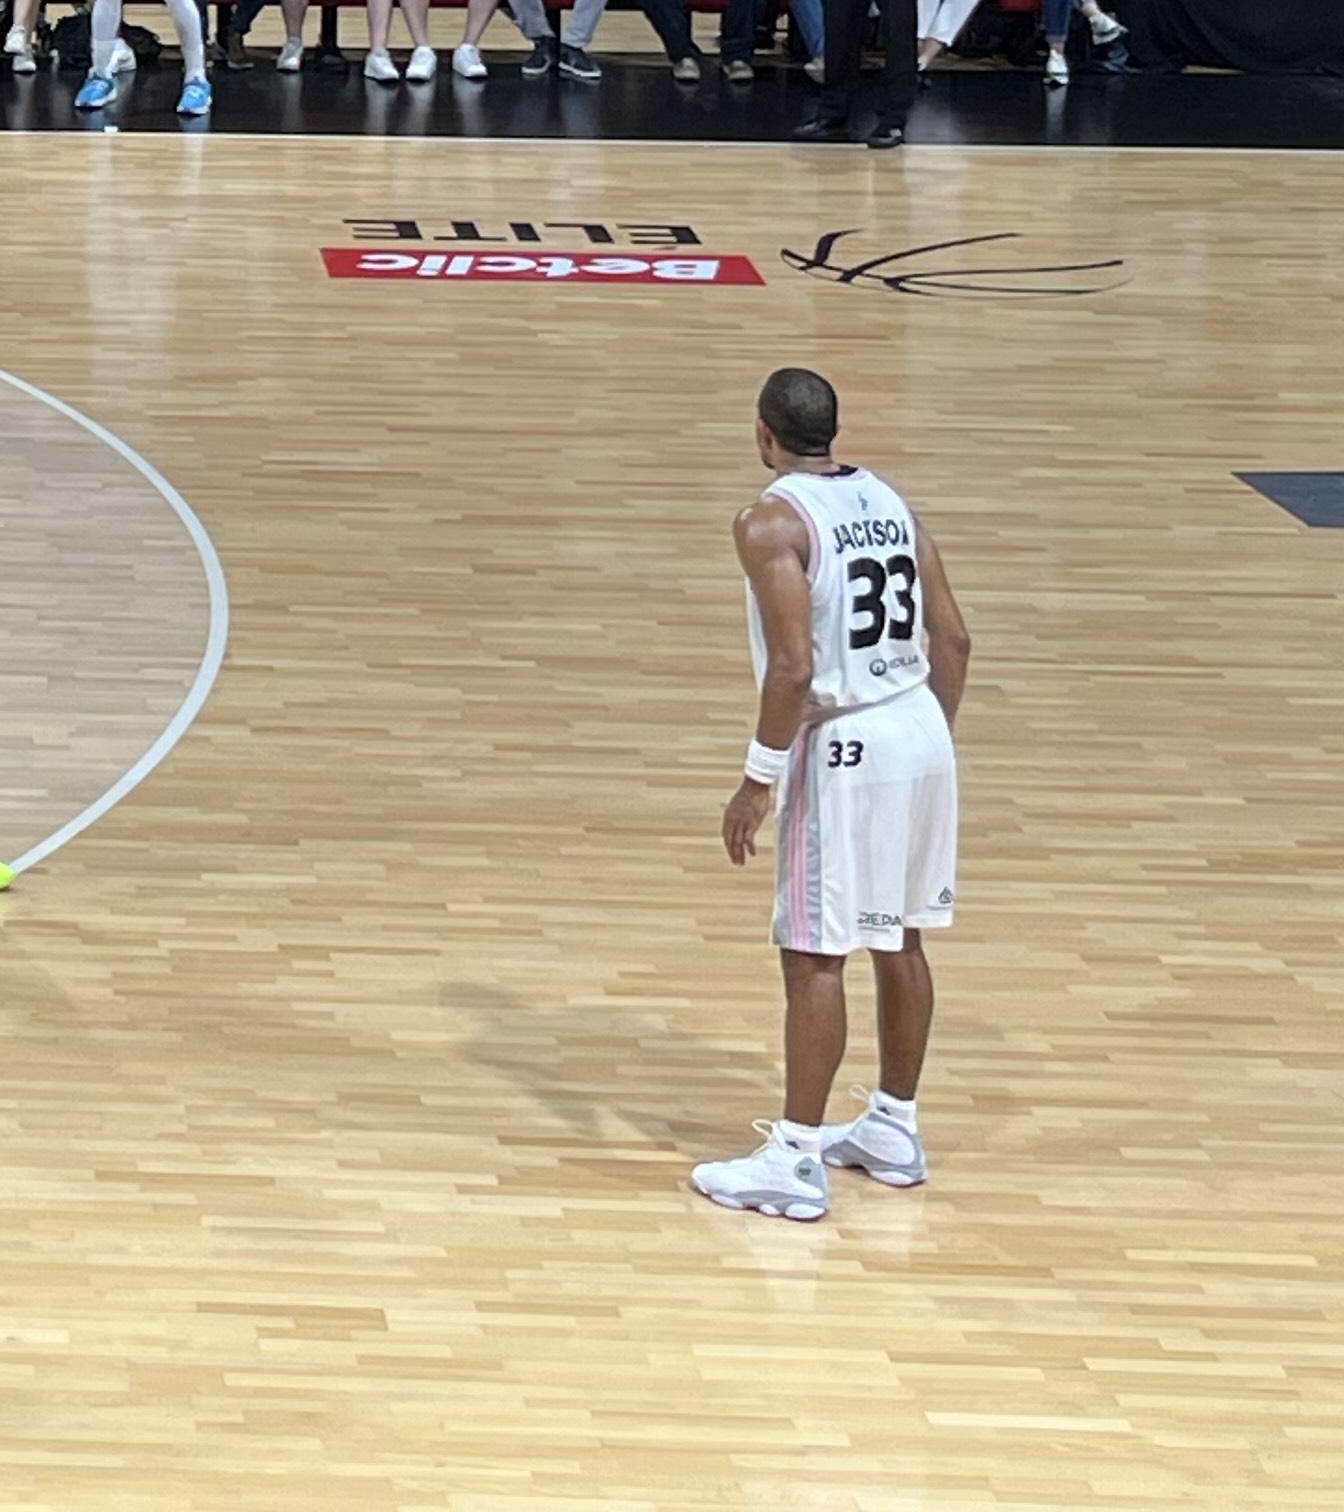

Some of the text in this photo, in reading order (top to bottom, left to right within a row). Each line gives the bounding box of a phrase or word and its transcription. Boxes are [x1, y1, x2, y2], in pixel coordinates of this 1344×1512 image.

[356, 254, 721, 281] Betclic
[847, 553, 917, 651] 33
[827, 740, 865, 768] 33
